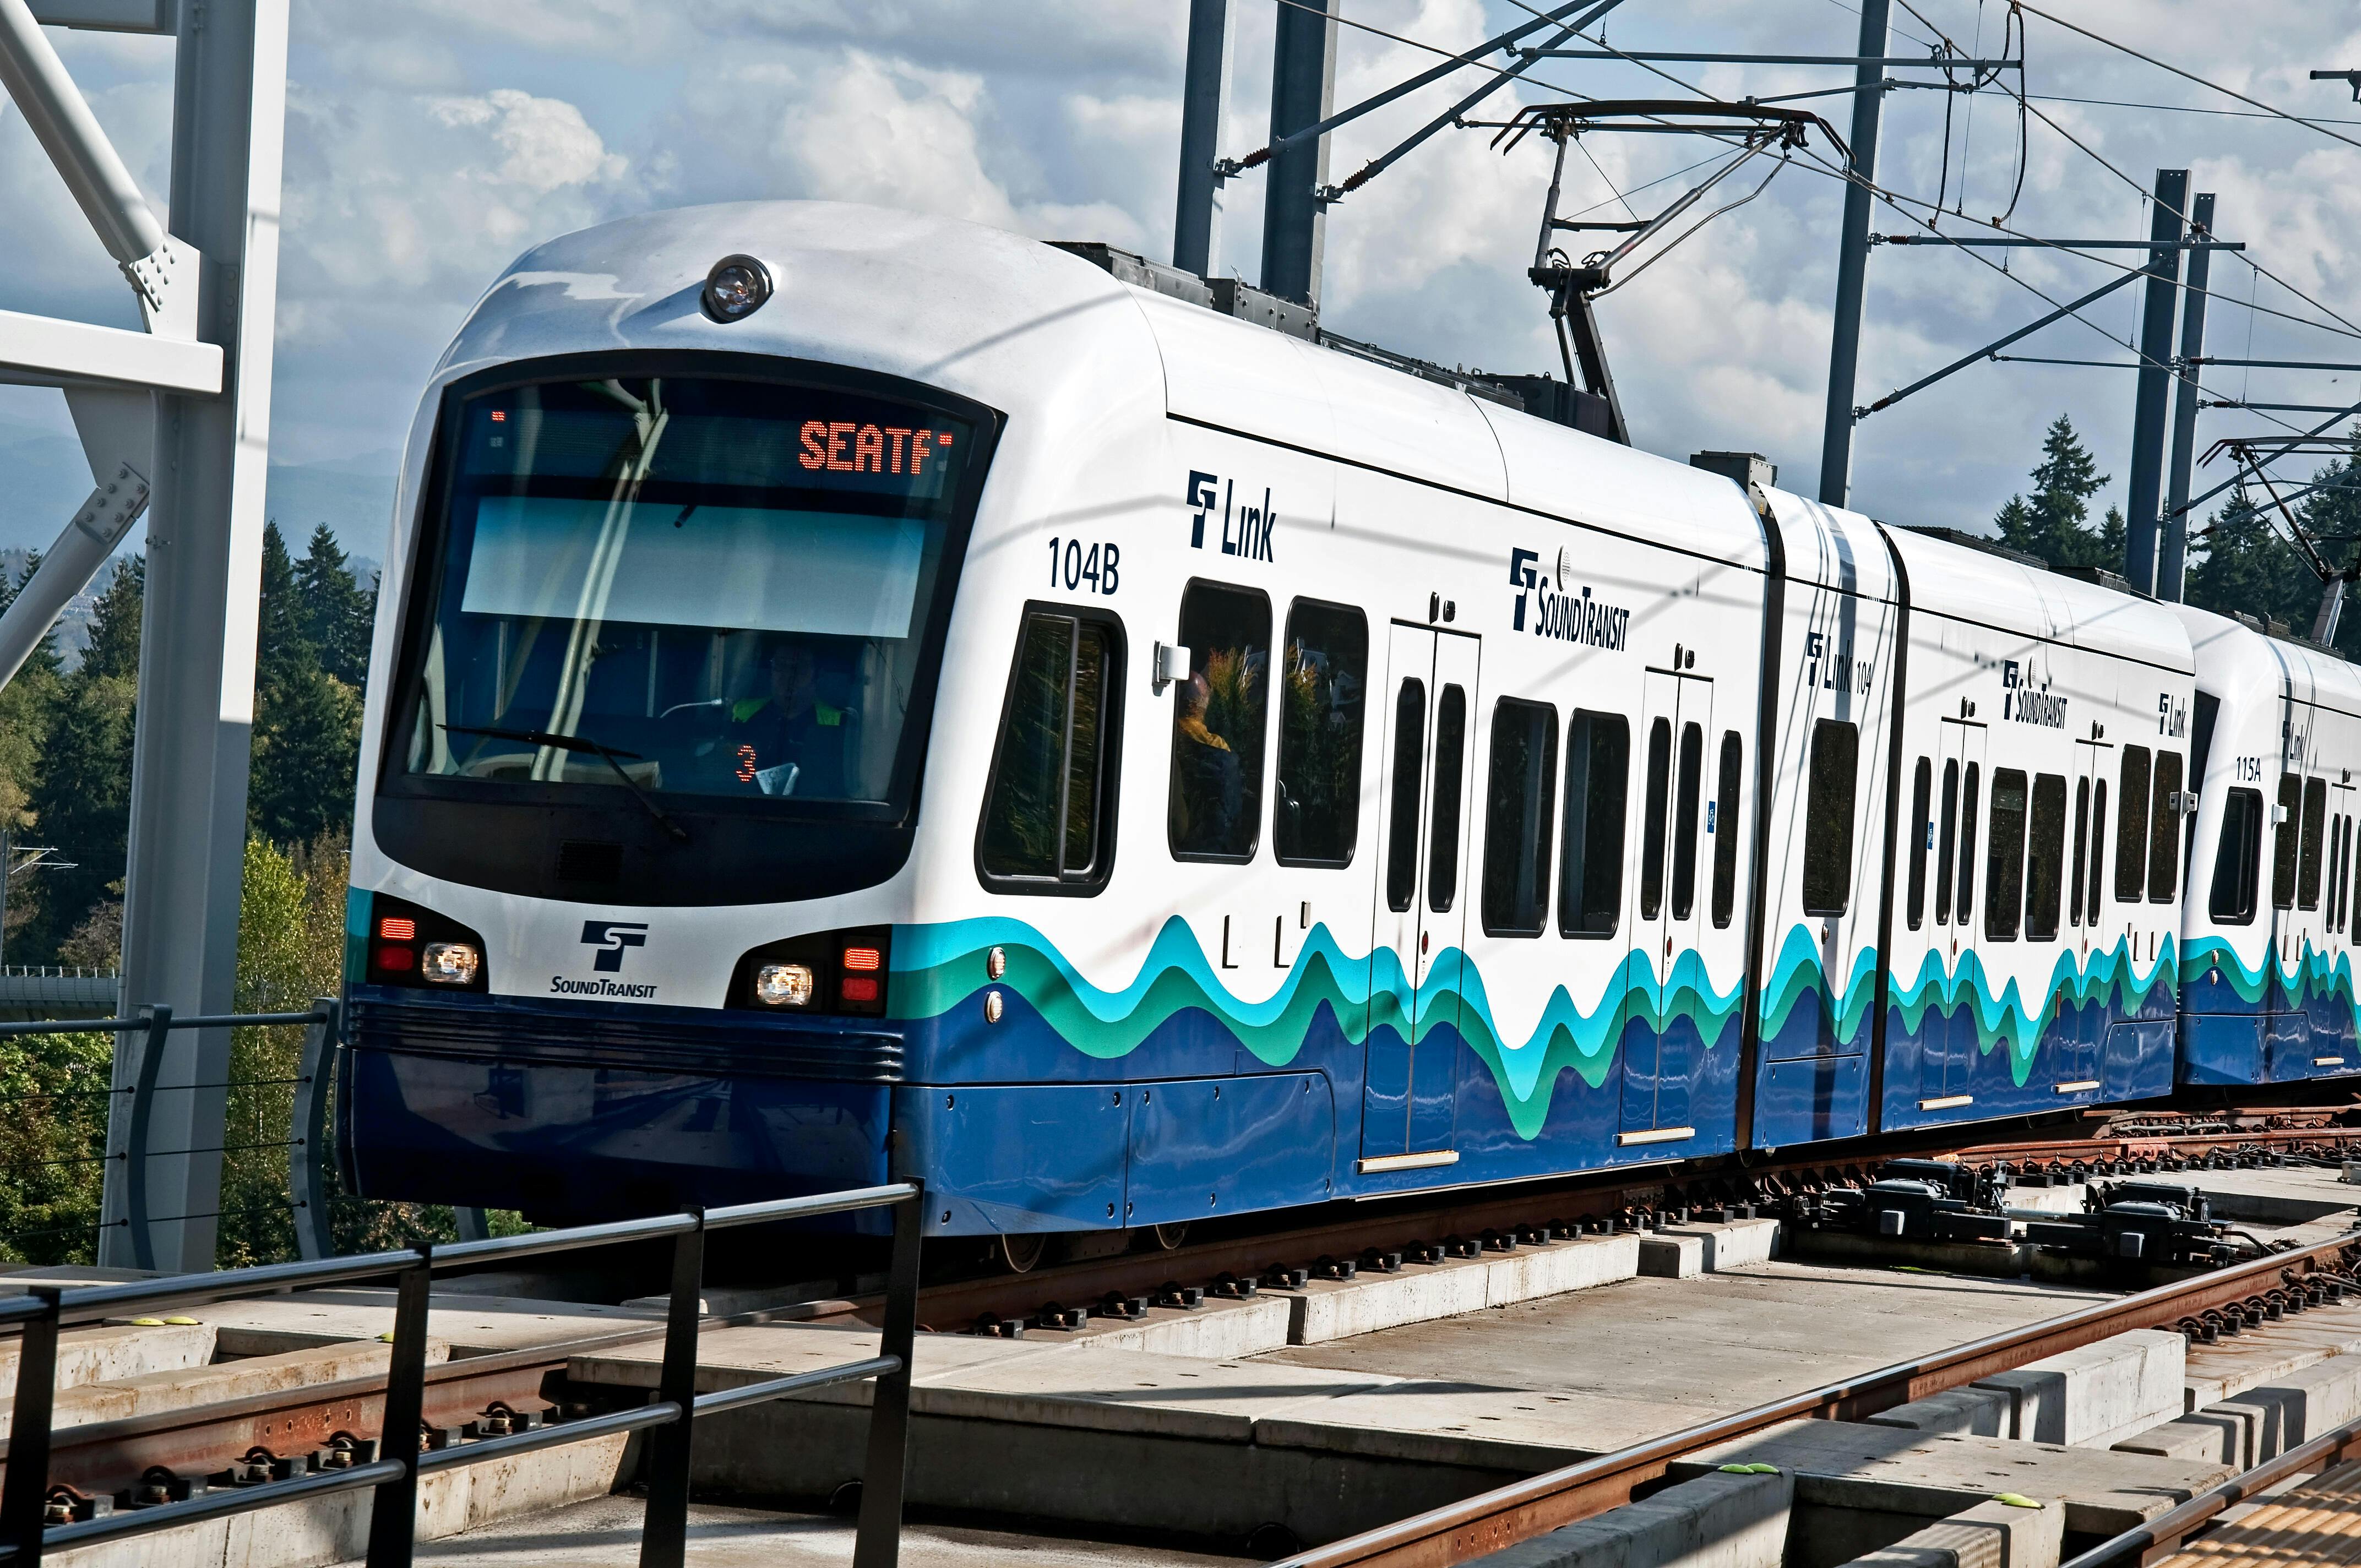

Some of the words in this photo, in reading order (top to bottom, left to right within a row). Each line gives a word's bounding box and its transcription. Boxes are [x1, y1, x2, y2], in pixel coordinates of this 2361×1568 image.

[1222, 479, 1276, 563] Link
[1049, 537, 1119, 595] 104B
[1824, 635, 1853, 693] Link
[1857, 661, 1871, 695] 104
[2169, 695, 2186, 738] Link
[735, 744, 756, 782] 3
[2289, 723, 2304, 761] Link
[2237, 756, 2260, 781] 115A
